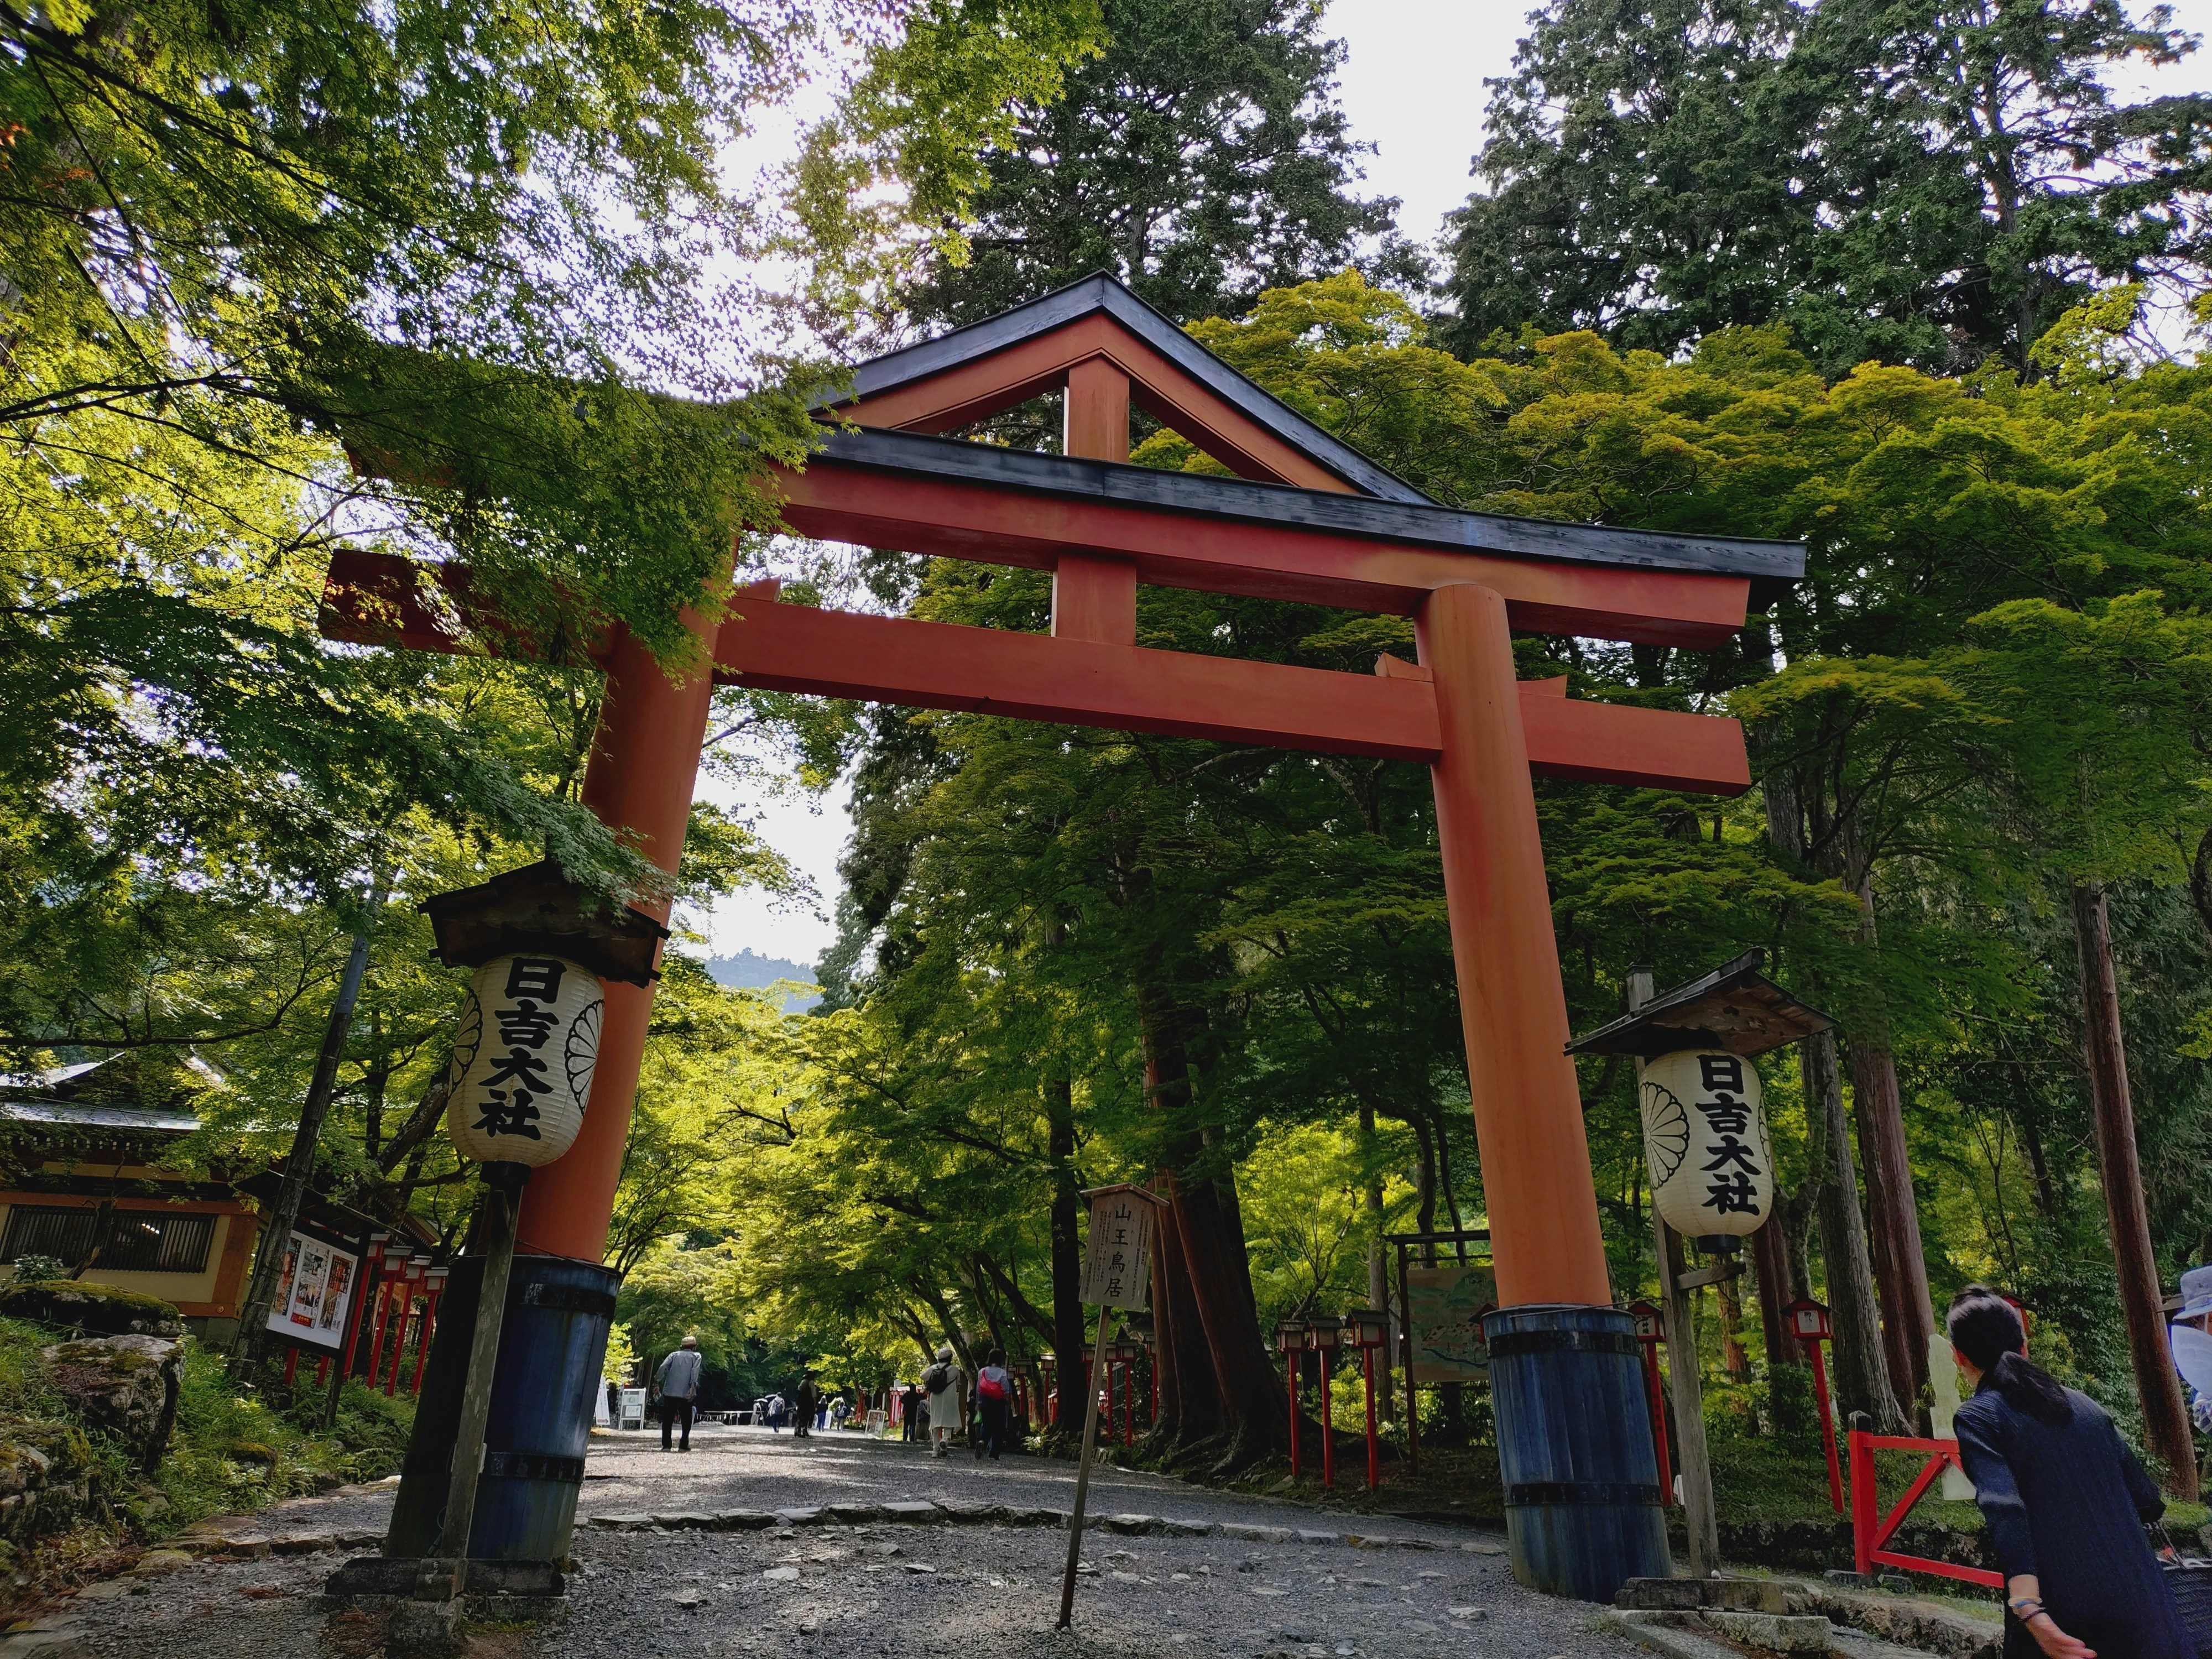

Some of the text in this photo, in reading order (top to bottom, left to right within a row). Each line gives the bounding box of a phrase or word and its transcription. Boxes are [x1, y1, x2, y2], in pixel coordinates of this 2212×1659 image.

[471, 957, 567, 1140] 日吉大社
[1694, 1054, 1762, 1215] 日吉大社
[1104, 1203, 1132, 1298] 山王鳥居
